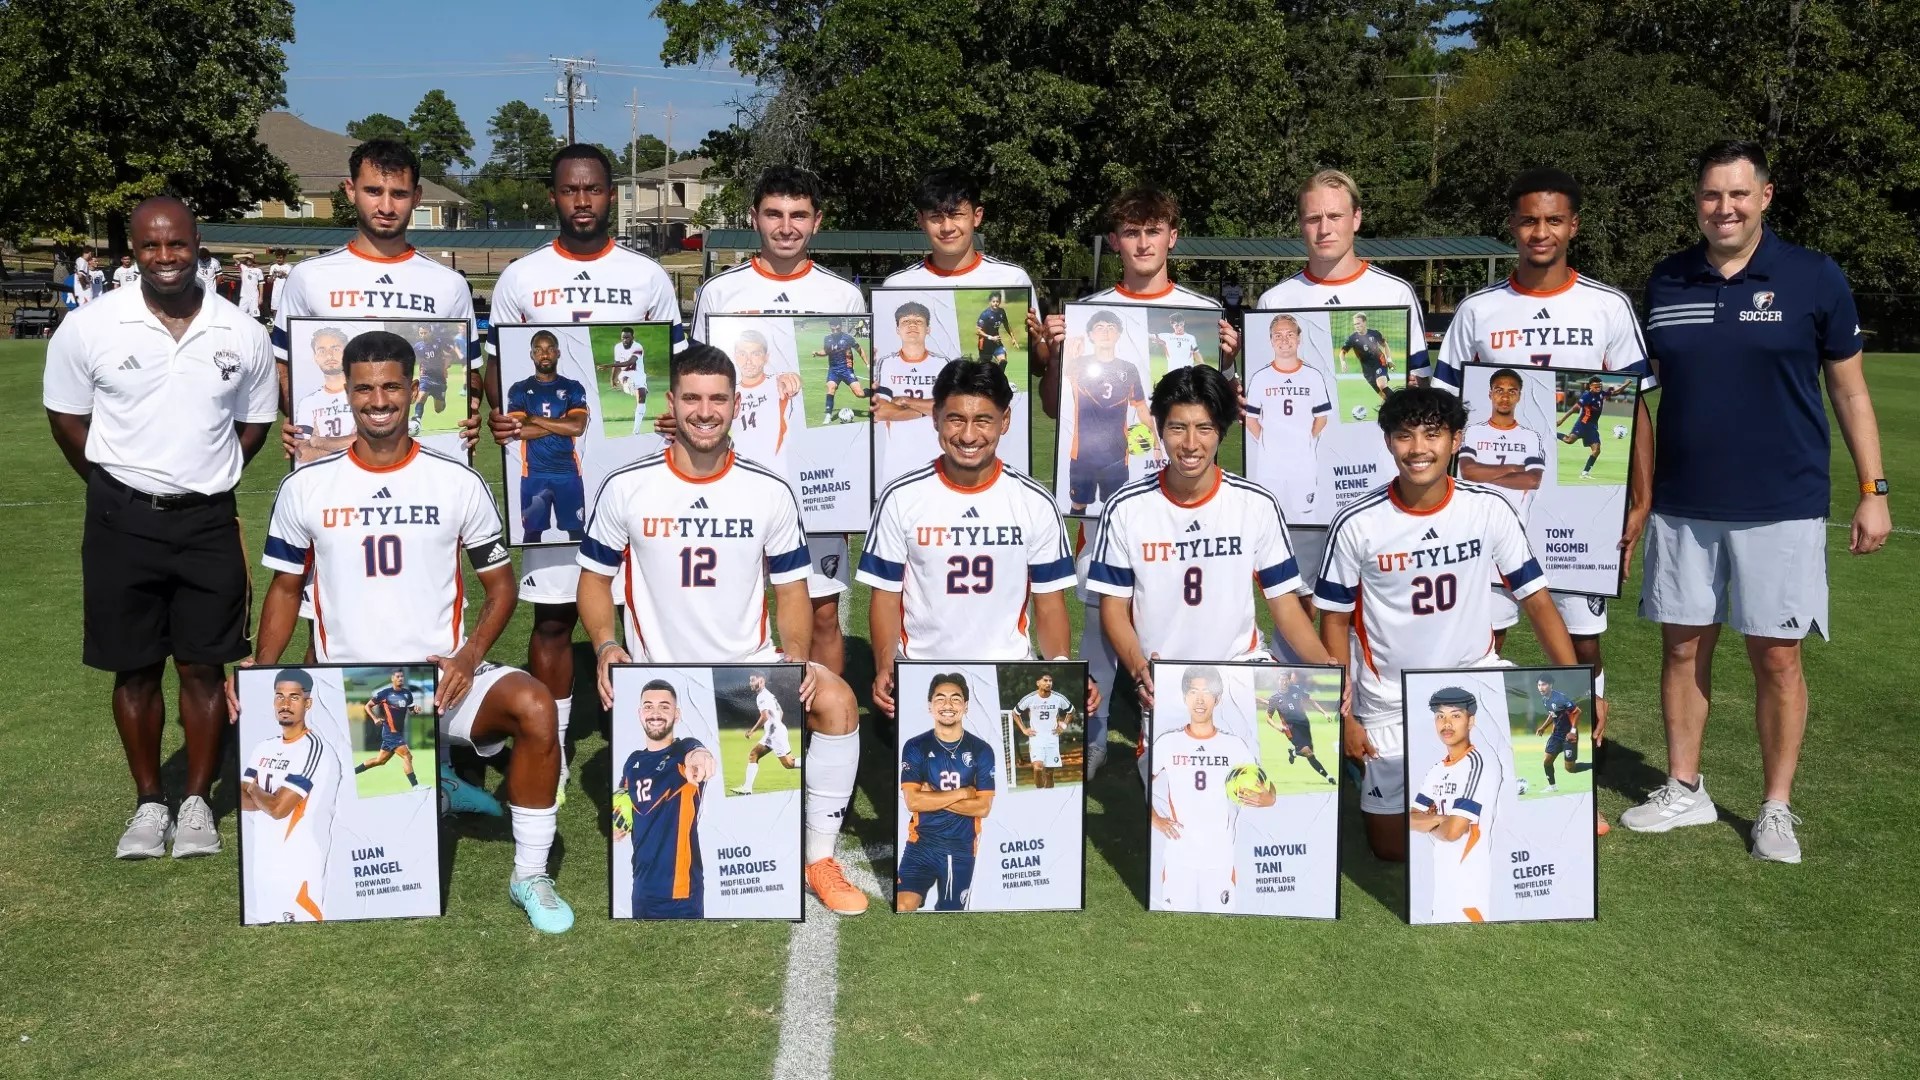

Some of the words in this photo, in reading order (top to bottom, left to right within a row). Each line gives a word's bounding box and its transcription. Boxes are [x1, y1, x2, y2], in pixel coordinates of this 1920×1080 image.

[329, 290, 360, 308] UT
[362, 290, 436, 314] TYLER
[533, 288, 561, 308] UT
[563, 286, 633, 306] TYLER
[1739, 310, 1783, 322] SOCCER
[1491, 329, 1519, 350] UT
[1522, 327, 1594, 346] TYLER
[1102, 383, 1113, 399] 3
[1265, 387, 1279, 397] UT
[1280, 387, 1311, 397] TYLER
[541, 403, 551, 418] 5
[1283, 399, 1293, 416] 6
[324, 417, 342, 438] 30
[740, 411, 757, 431] 14
[1476, 441, 1490, 451] UT
[1492, 442, 1527, 453] TYLER
[800, 468, 835, 482] DANNY
[1333, 463, 1377, 476] WILLIAM
[1334, 478, 1369, 491] KENNE
[802, 495, 836, 505] MIDFIELDER
[820, 503, 835, 511] TEXAS
[322, 507, 355, 528] UT
[359, 505, 441, 526] TYLER
[643, 517, 675, 538] UT
[678, 517, 755, 538] TYLER
[1545, 528, 1575, 539] TONY
[916, 526, 947, 547] UT
[950, 525, 1024, 546] TYLER
[1142, 542, 1172, 562] UT
[1175, 536, 1243, 561] TYLER
[1377, 552, 1408, 572] UT
[1411, 538, 1481, 569] TYLER
[1545, 542, 1589, 553] NGOMBI
[360, 534, 403, 578] 10
[678, 546, 718, 588] 12
[946, 554, 994, 595] 29
[1598, 563, 1618, 571] FRANCE
[1183, 566, 1203, 607] 8
[1410, 572, 1457, 616] 20
[1039, 710, 1050, 720] 29
[1172, 755, 1189, 766] UT
[1190, 755, 1229, 767] TYLER
[940, 770, 960, 791] 29
[1194, 770, 1207, 791] 8
[635, 778, 653, 803] 12
[351, 846, 385, 861] LUAN
[717, 845, 751, 860] HUGO
[999, 838, 1045, 854] CARLOS
[1254, 843, 1307, 857] NAOYUKI
[1001, 855, 1041, 870] GALAN
[1511, 850, 1530, 863] SID
[353, 860, 403, 878] RANGEL
[719, 859, 777, 876] MARQUES
[1002, 870, 1041, 880] MIDFIELDER
[1255, 861, 1282, 874] TANI
[1512, 863, 1556, 880] CLEOFE
[355, 877, 391, 889] FORWARD
[720, 876, 761, 887] MIDFIELDER
[1002, 880, 1033, 889] PEARLAND,
[1033, 878, 1050, 886] TEXAS
[1255, 876, 1296, 885] MIDFIELDER
[1513, 879, 1553, 891] MIDFIELDER
[356, 889, 367, 898] RIO
[367, 888, 375, 896] DE
[402, 882, 422, 892] BRAZIL
[731, 888, 739, 896] DE
[765, 883, 784, 892] BRAZIL
[1515, 890, 1533, 899] TYLER,
[1533, 888, 1551, 897] TEXAS
